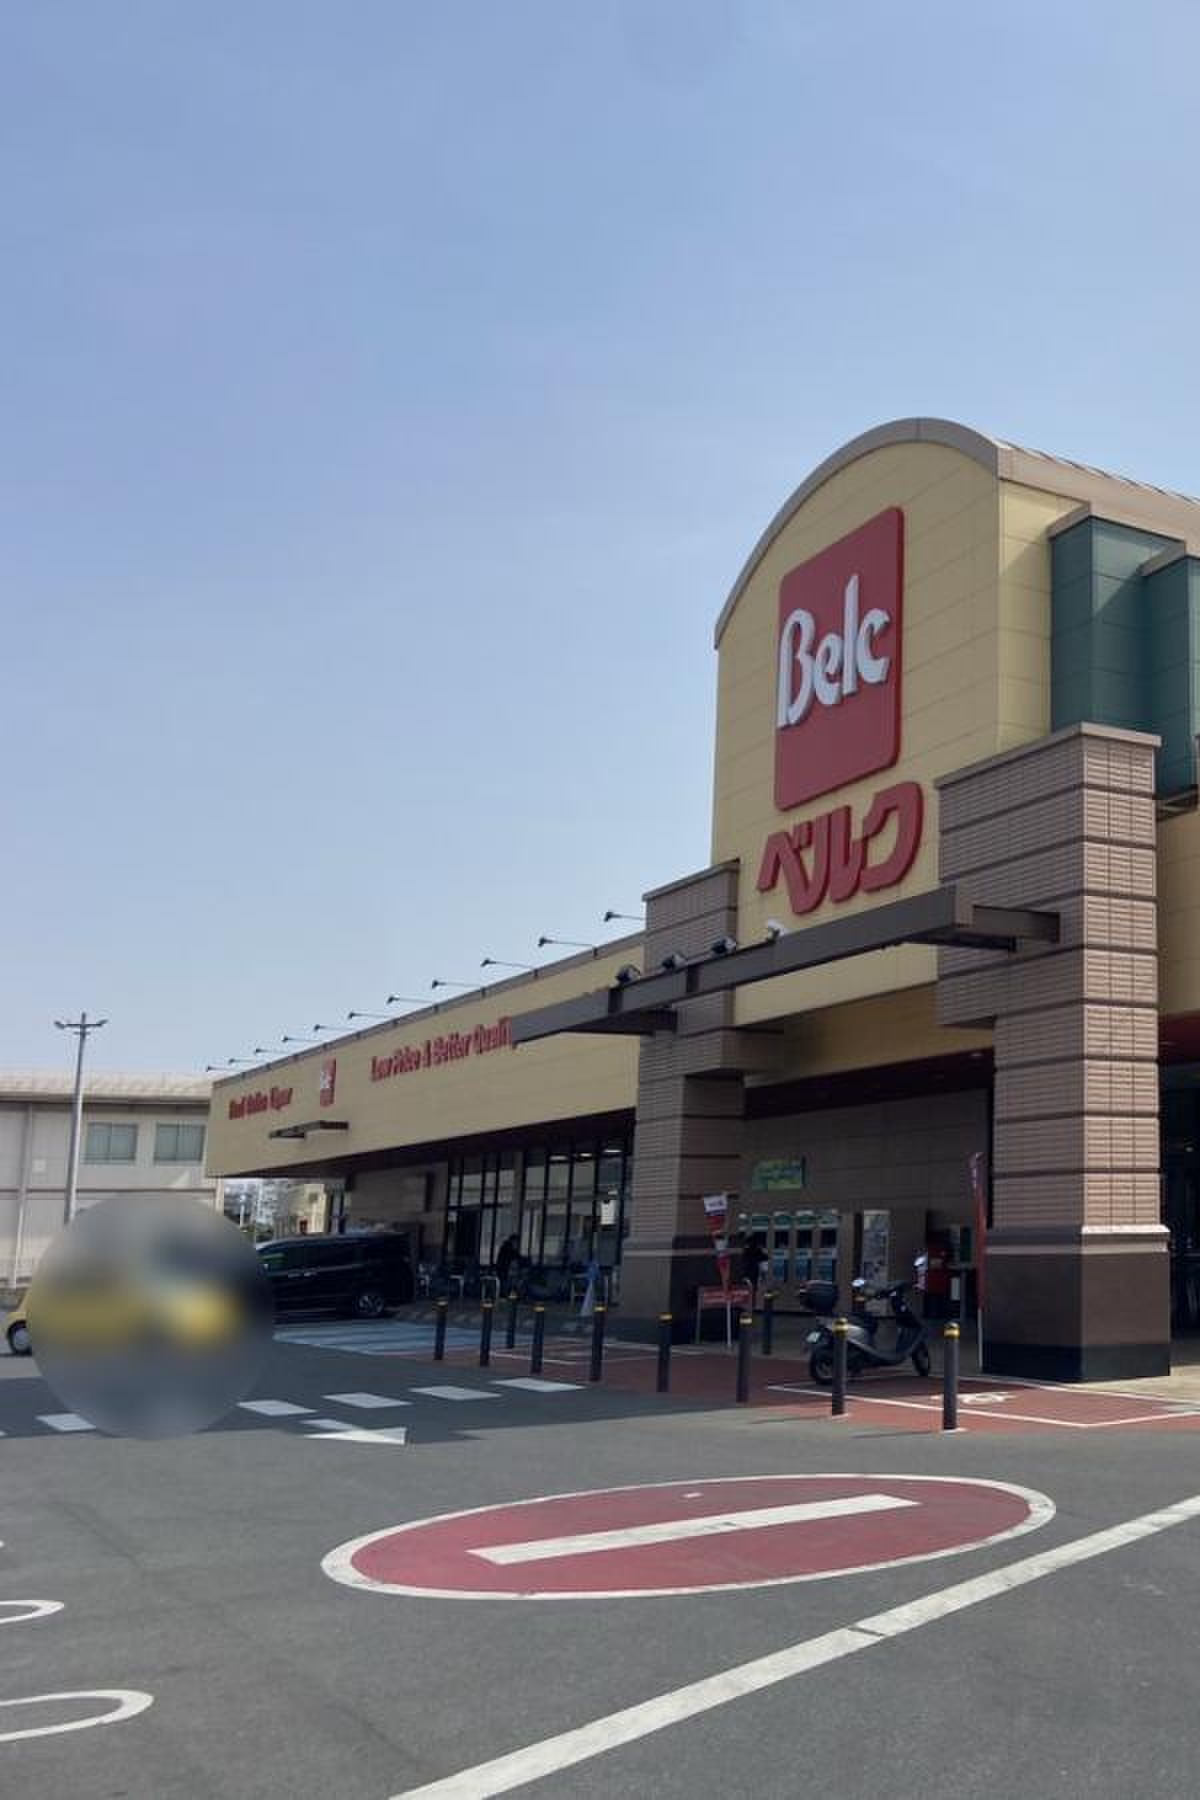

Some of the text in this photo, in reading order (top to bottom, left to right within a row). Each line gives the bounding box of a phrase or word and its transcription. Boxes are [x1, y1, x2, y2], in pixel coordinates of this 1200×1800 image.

[776, 573, 891, 729] Belc
[757, 781, 923, 914] ベルク
[473, 1015, 512, 1055] Quali
